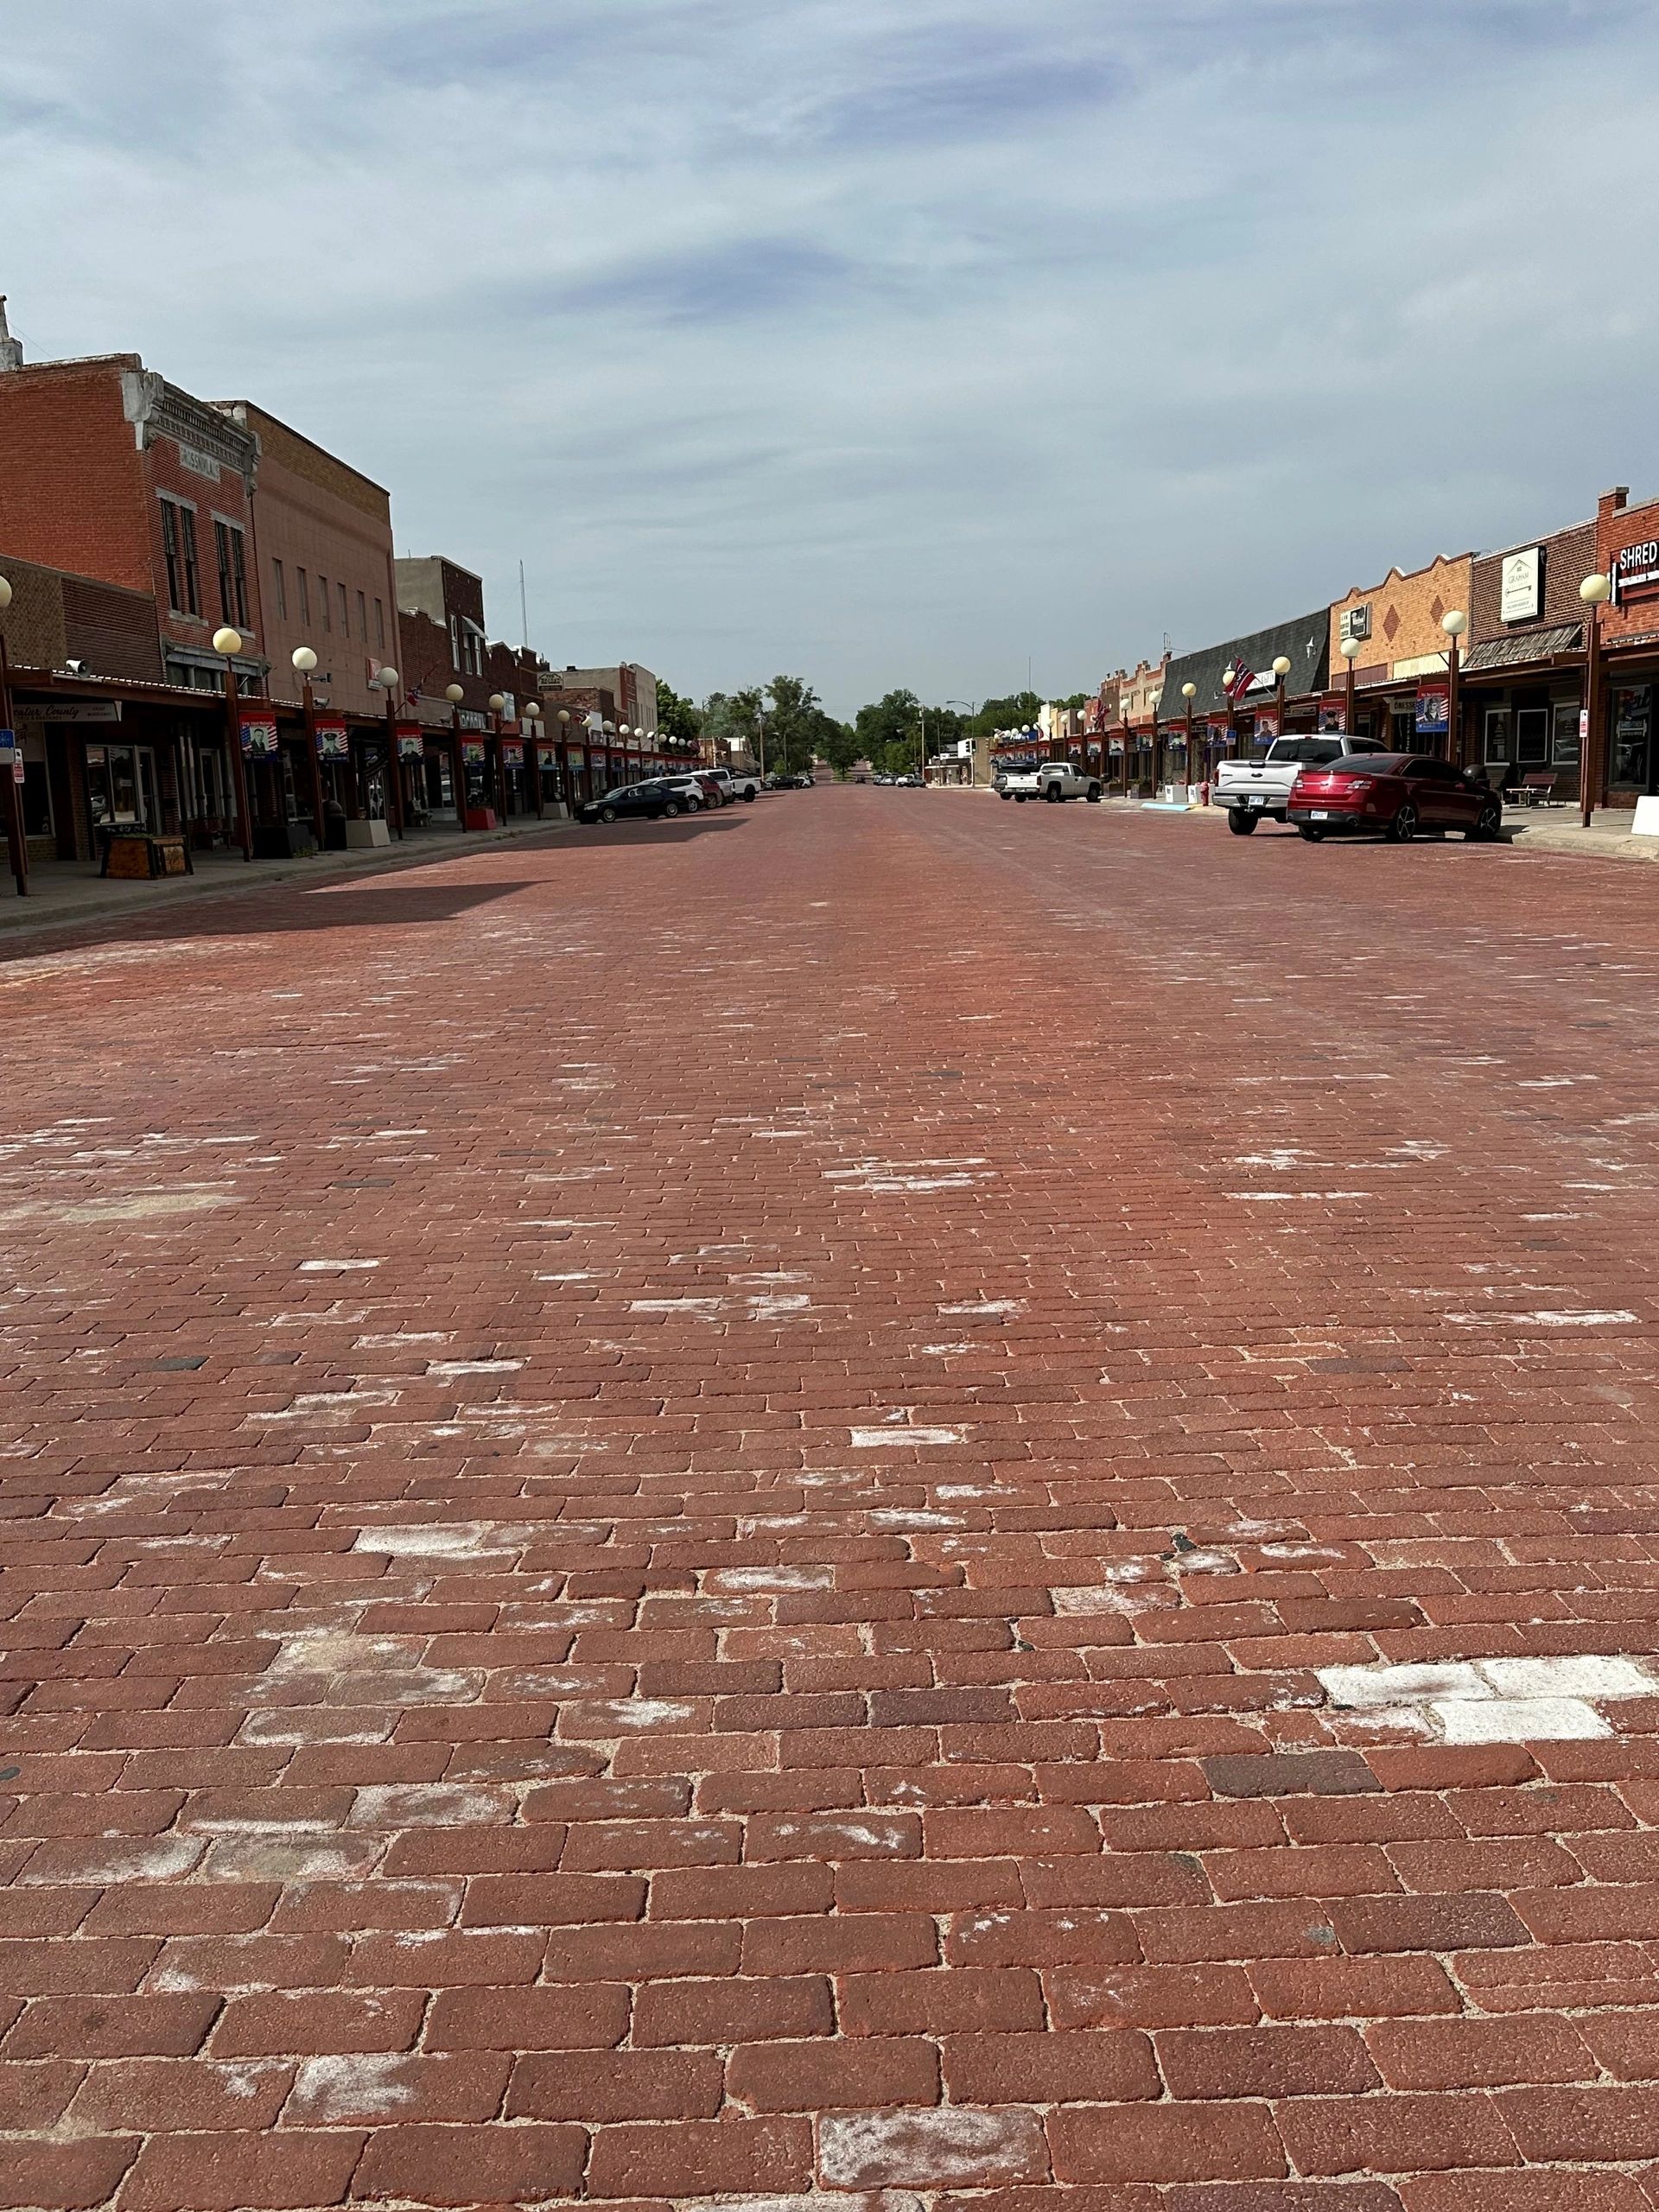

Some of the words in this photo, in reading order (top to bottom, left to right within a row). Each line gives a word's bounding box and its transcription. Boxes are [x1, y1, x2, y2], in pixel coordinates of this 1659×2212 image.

[1619, 541, 1657, 570] SHRED
[1508, 572, 1529, 584] GRAHAM
[46, 705, 79, 719] County
